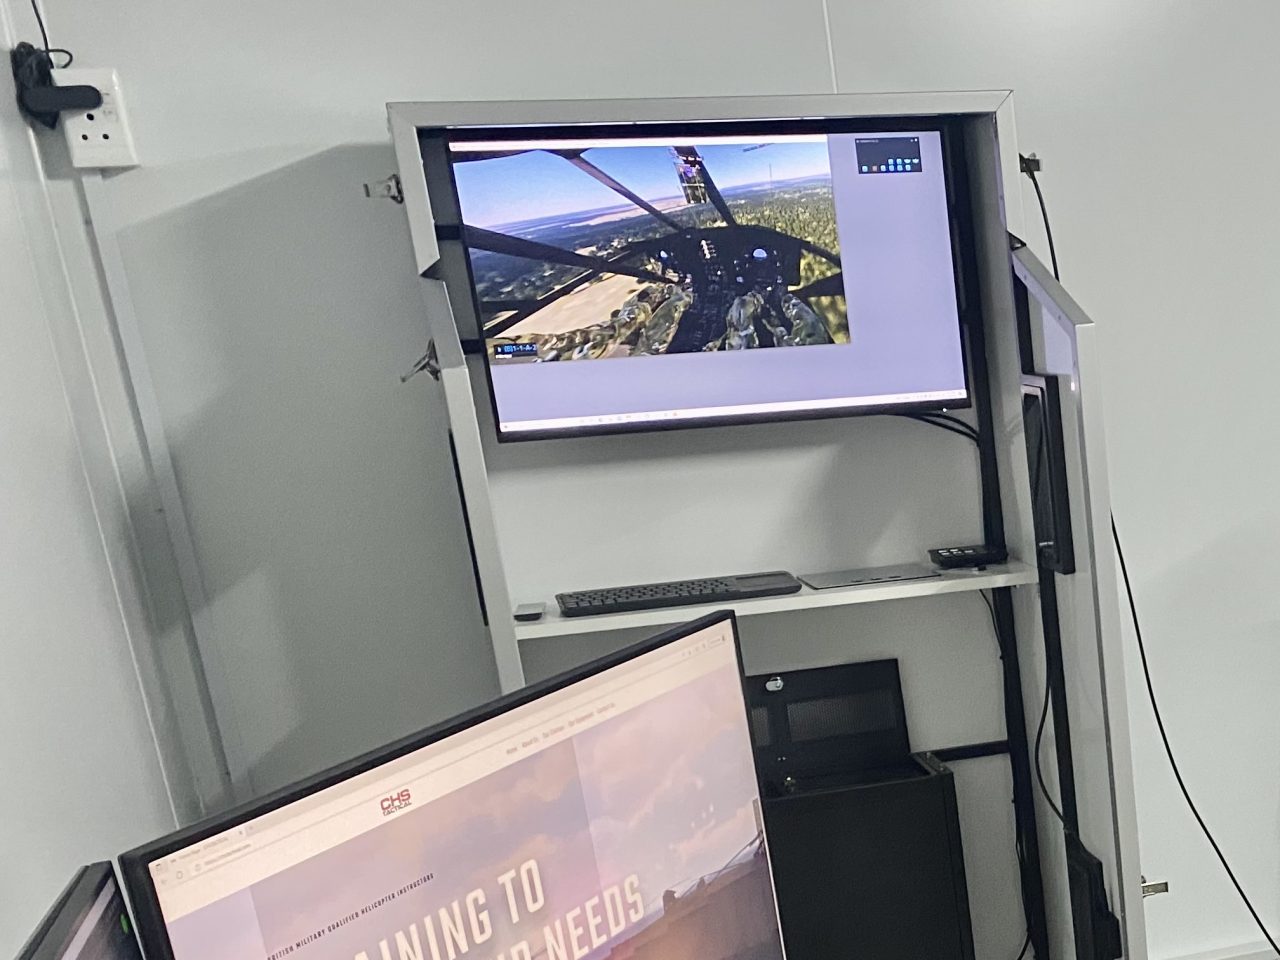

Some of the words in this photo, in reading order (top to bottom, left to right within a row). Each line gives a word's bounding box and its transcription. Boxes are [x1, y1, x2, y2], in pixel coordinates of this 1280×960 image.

[380, 788, 411, 811] CHS
[295, 929, 325, 949] MILITARY
[327, 911, 359, 933] QUALIFIED
[361, 892, 396, 916] HELICOPTER
[397, 872, 434, 897] INSTRUCTORS
[497, 859, 545, 924] TO
